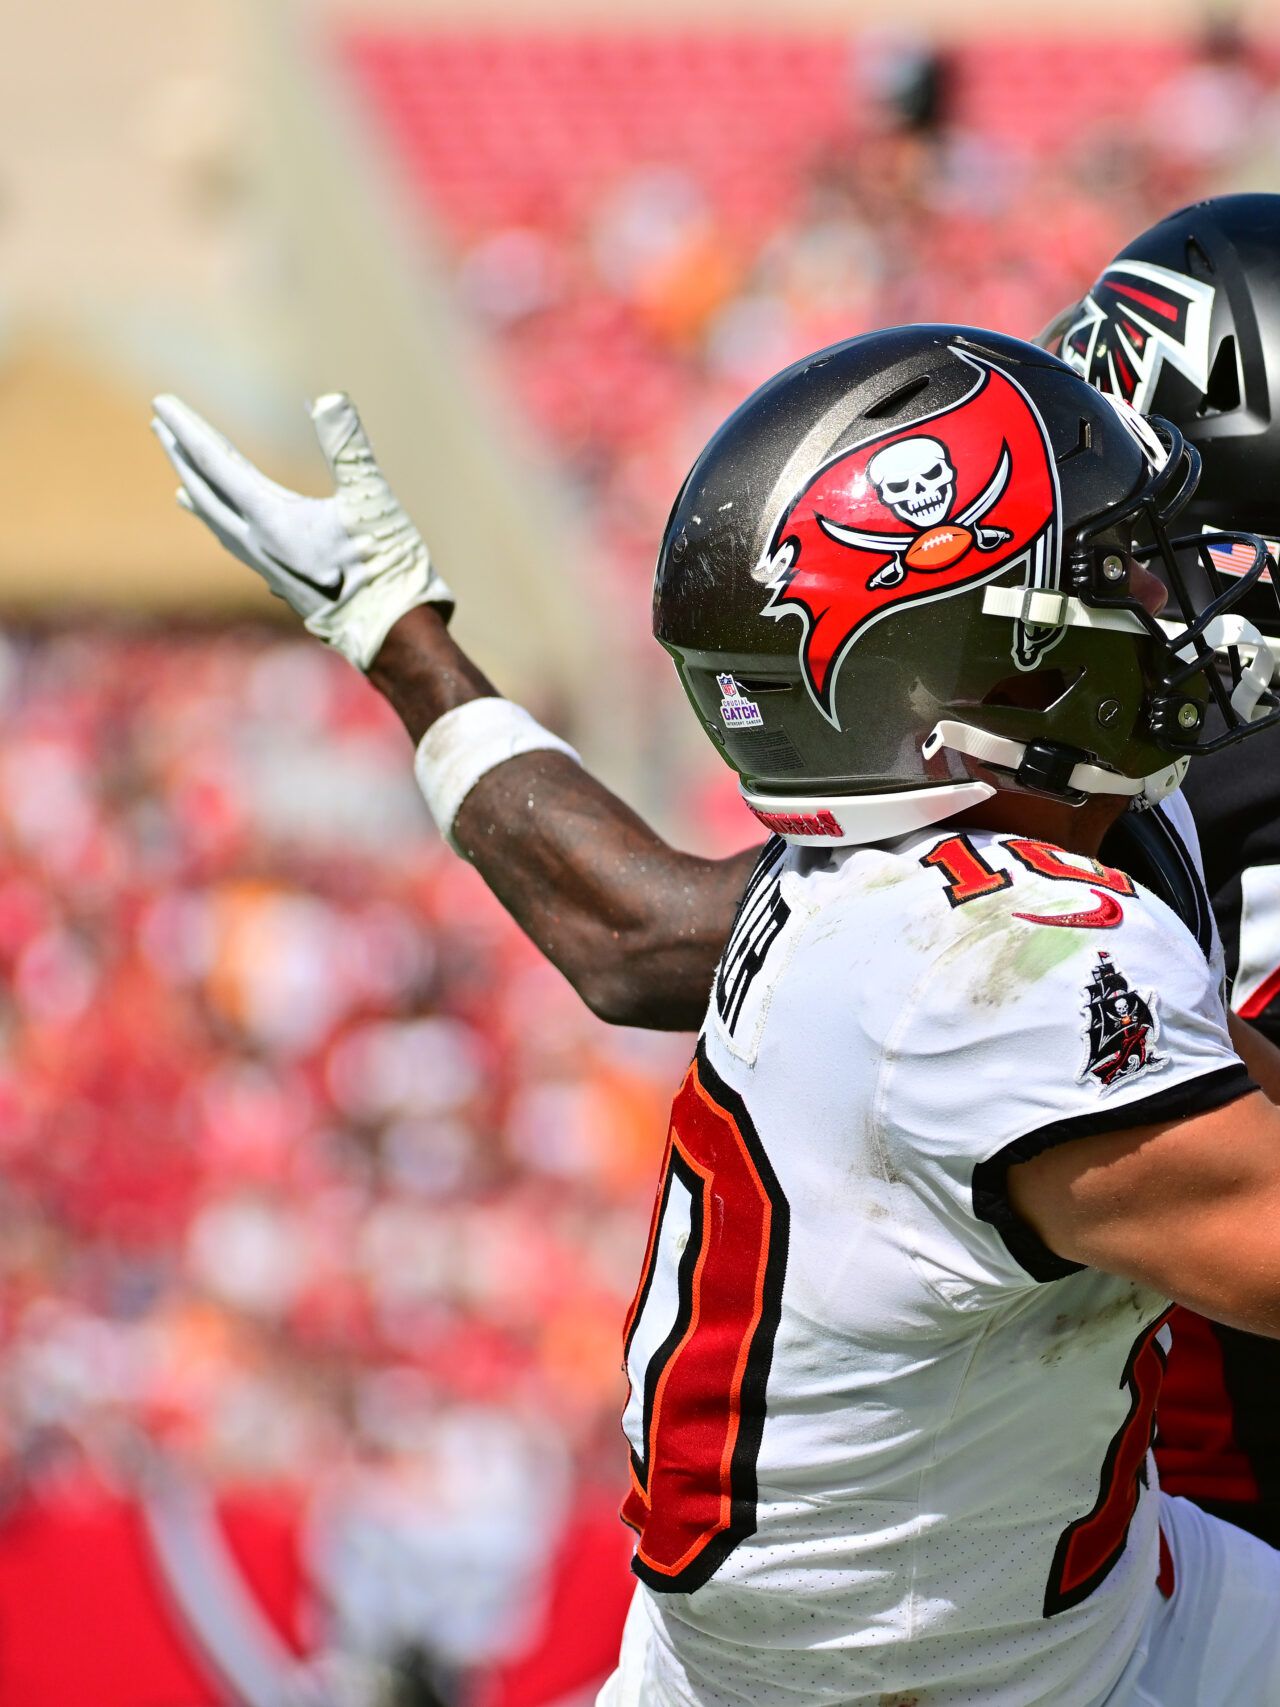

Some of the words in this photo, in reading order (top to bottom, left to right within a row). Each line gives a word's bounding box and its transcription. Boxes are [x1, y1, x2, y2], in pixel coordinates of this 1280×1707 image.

[723, 698, 749, 708] CRUCIAL
[722, 705, 759, 721] CATCH
[919, 833, 1139, 909] 10
